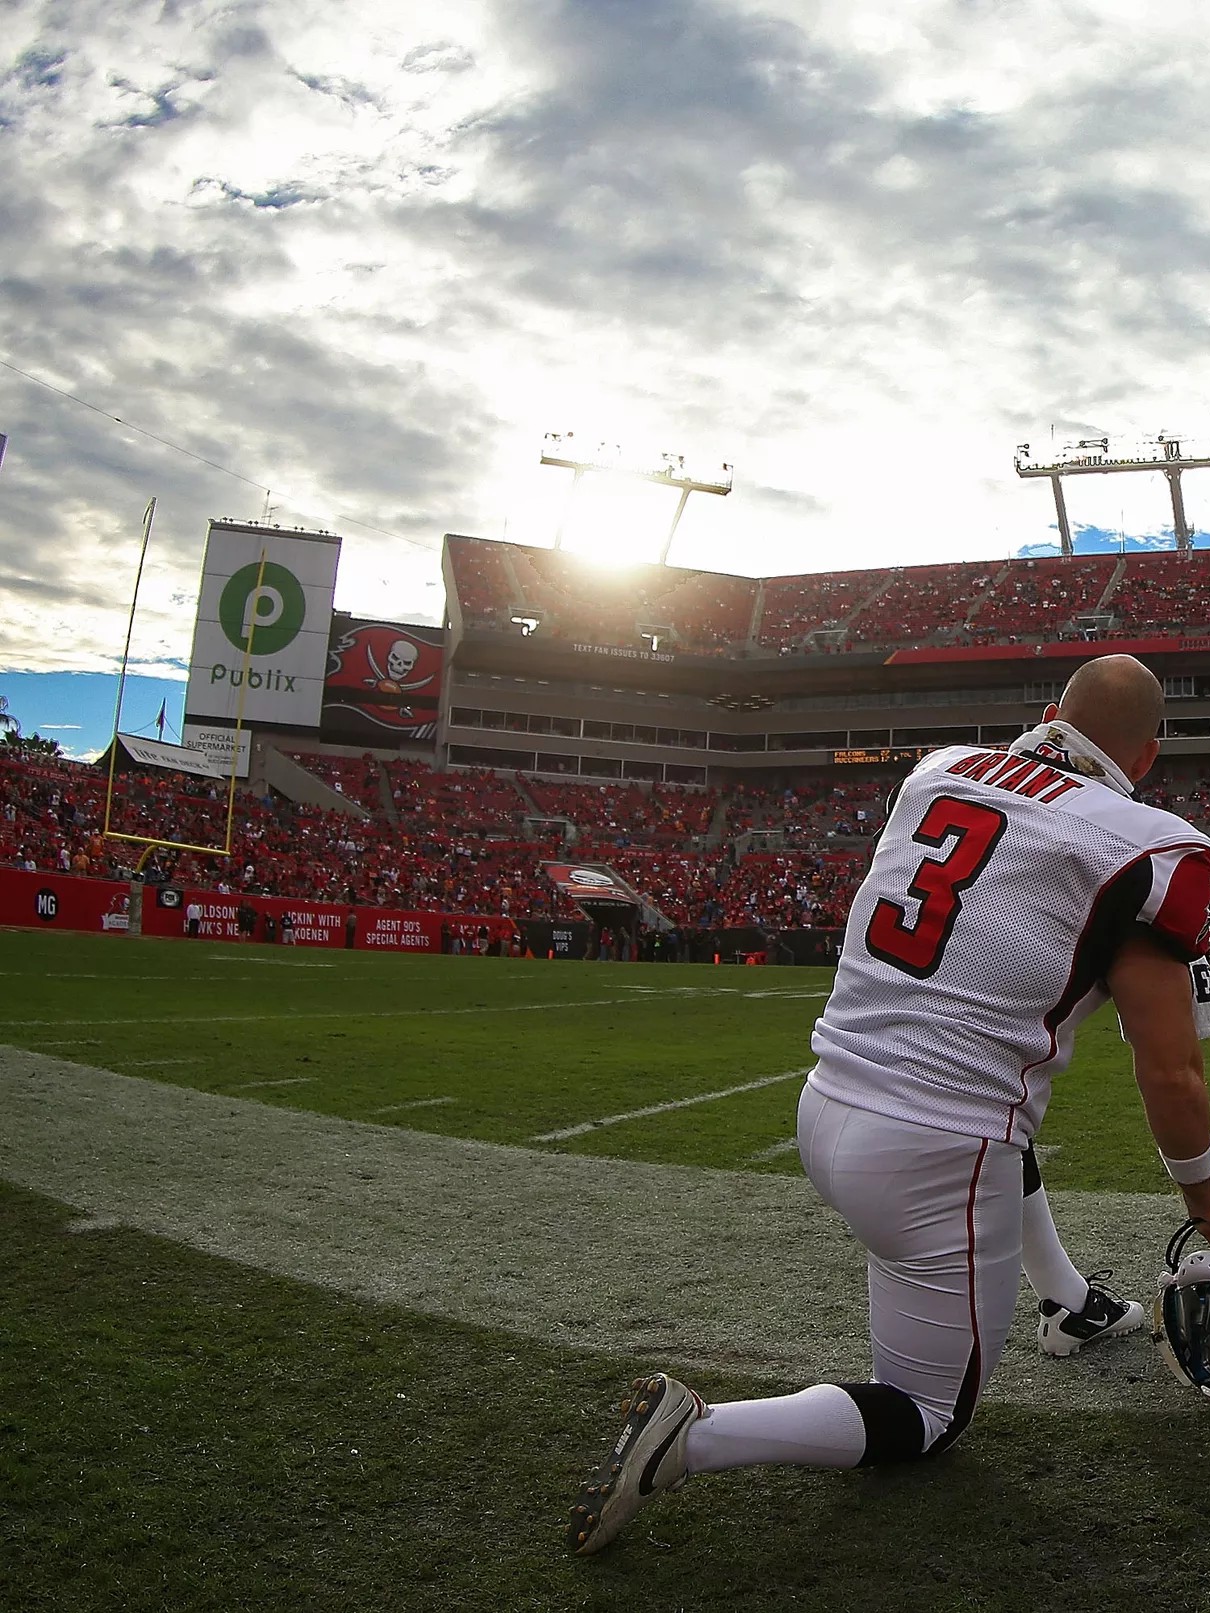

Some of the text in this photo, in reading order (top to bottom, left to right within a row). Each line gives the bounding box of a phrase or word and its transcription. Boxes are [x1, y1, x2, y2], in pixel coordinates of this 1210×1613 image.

[573, 643, 592, 652] TEXT
[594, 646, 608, 655] FAN
[610, 648, 637, 658] ISSUES
[199, 732, 235, 744] OFFICIAL
[187, 740, 246, 753] SUPERMARKET
[945, 752, 1085, 804] BRYANT
[864, 795, 1008, 981] 3
[37, 894, 56, 915] MG
[198, 904, 240, 920] OLDSON'
[282, 910, 341, 928] ICKIN' WITH
[375, 919, 421, 933] AGENT 90'S
[183, 919, 223, 936] HWK'S
[295, 927, 329, 942] KOENEN
[366, 933, 430, 947] SPECIAL AGENTS
[552, 930, 573, 941] DOUG'S
[555, 942, 569, 952] VIPS
